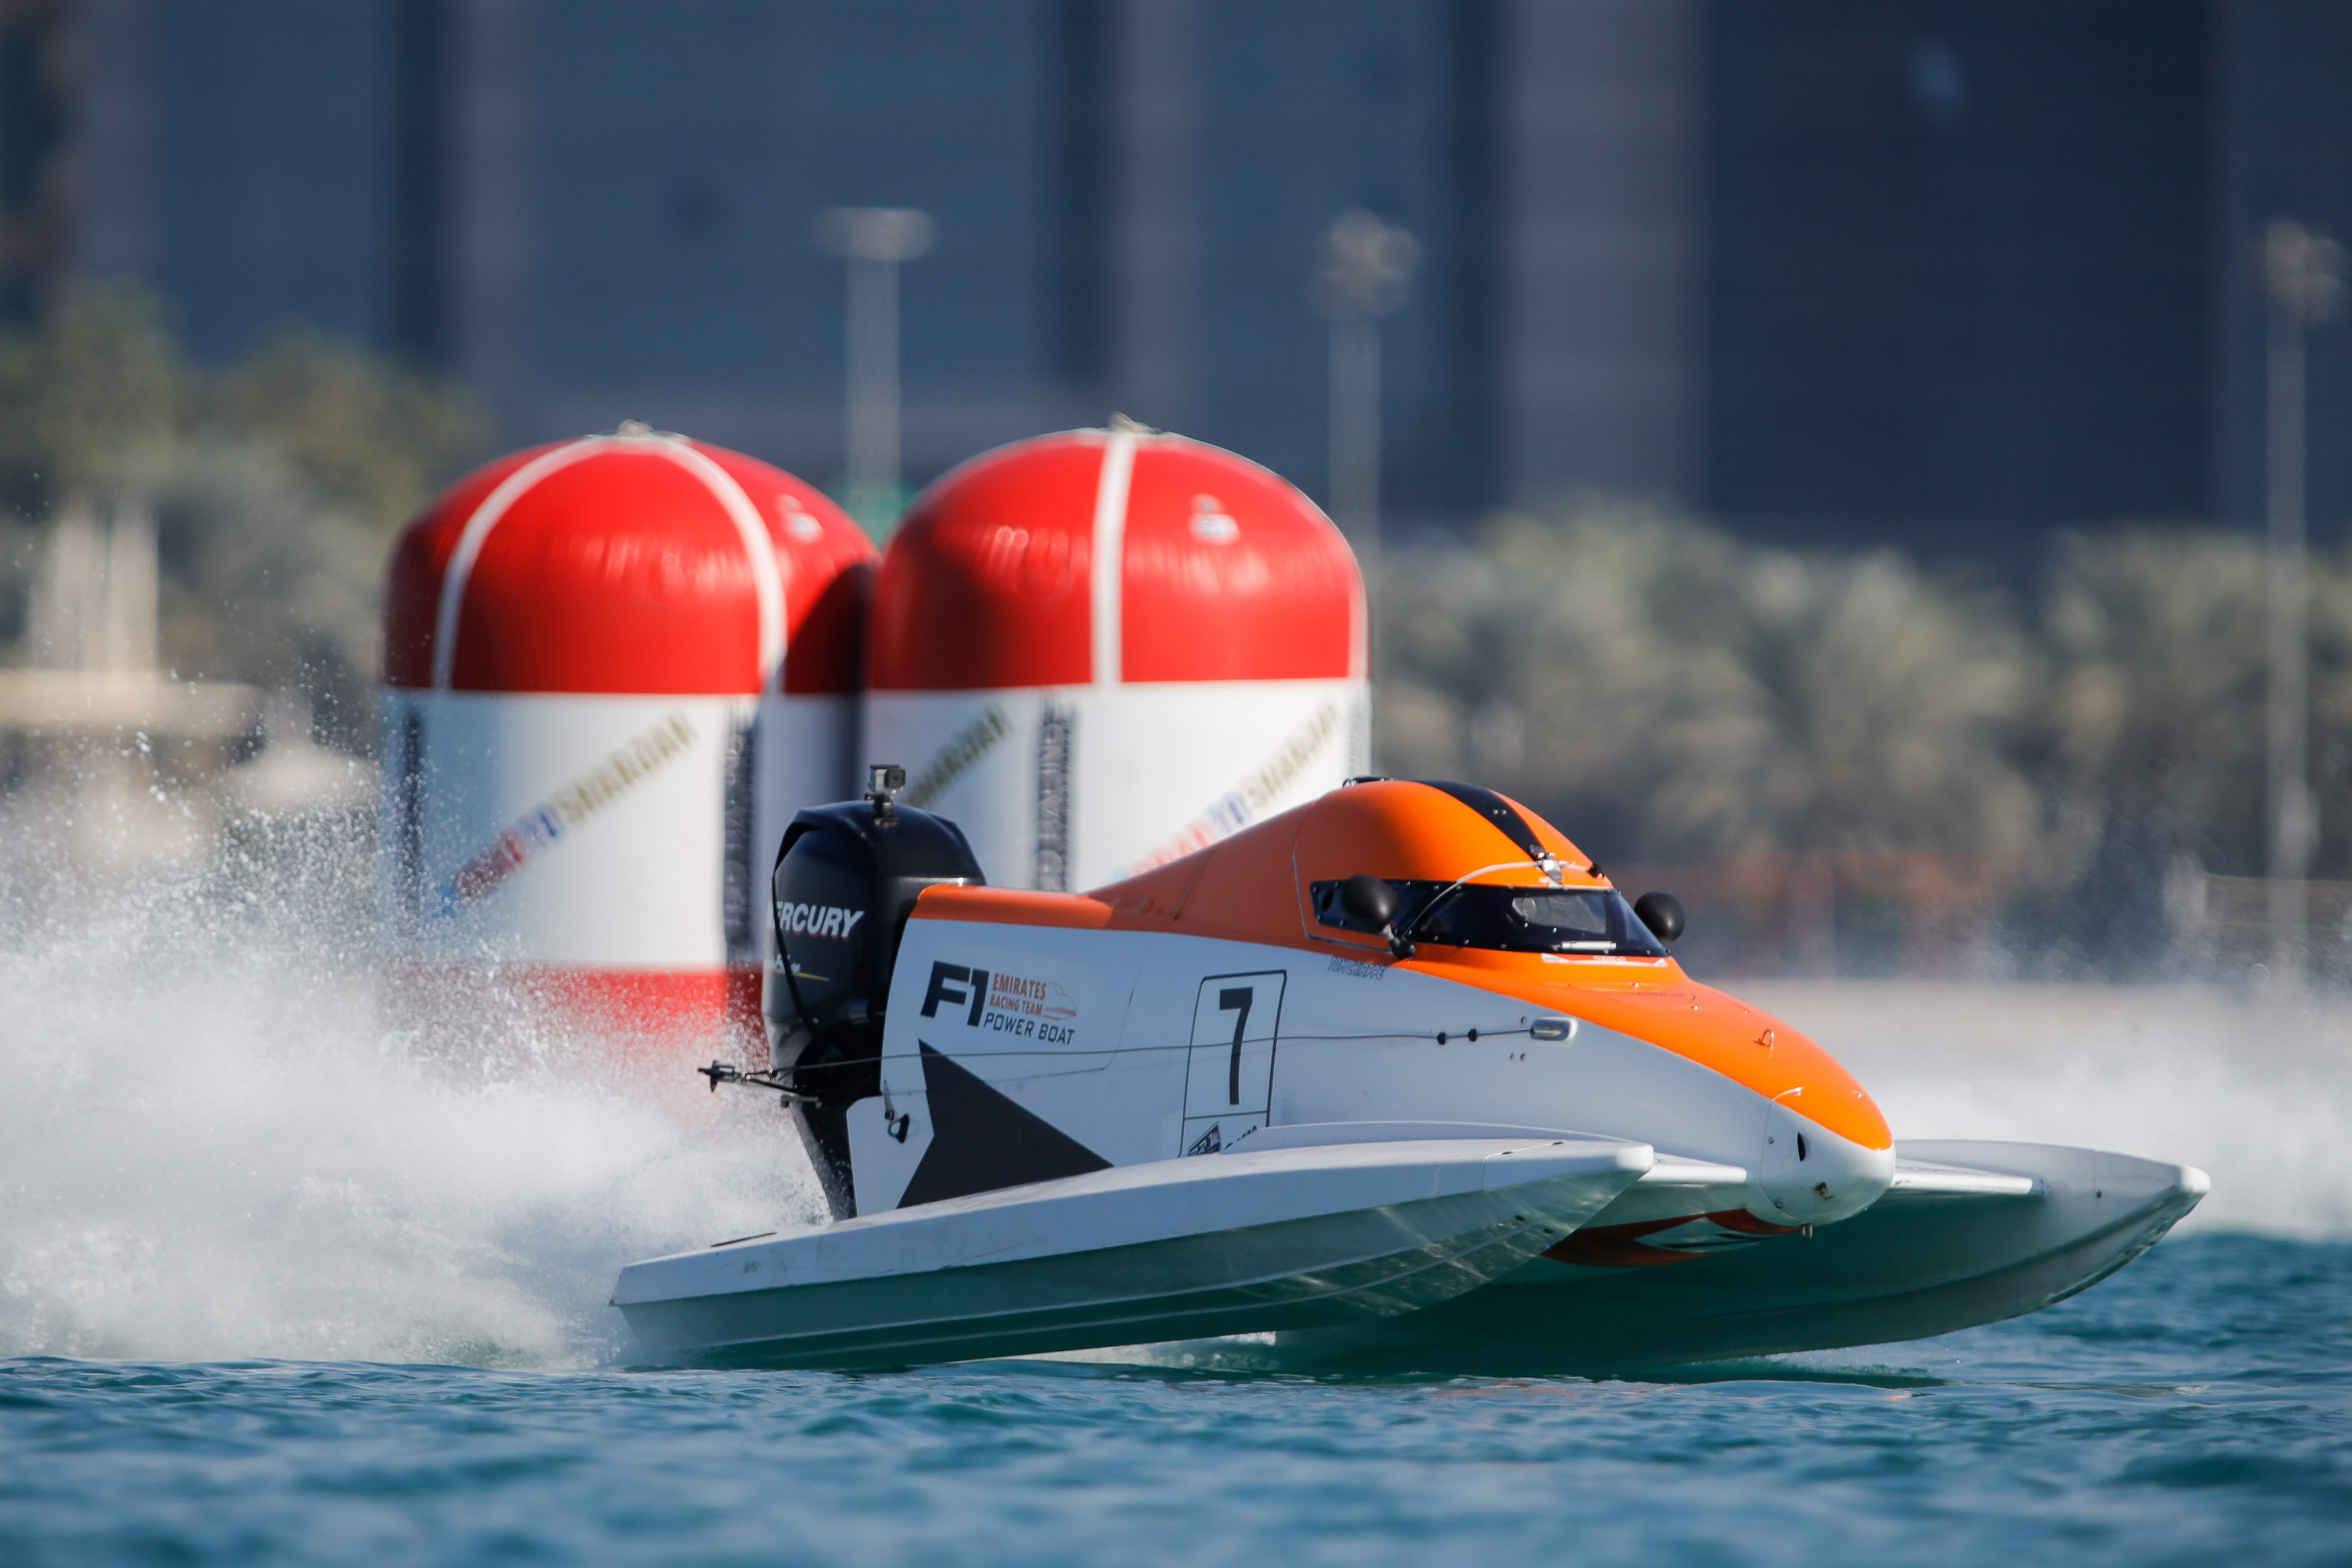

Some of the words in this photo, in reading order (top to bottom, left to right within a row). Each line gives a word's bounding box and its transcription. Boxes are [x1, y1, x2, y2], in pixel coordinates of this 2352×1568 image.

[920, 960, 990, 1027] F1
[993, 973, 1047, 1001] EMIRATES
[990, 994, 1020, 1012] RACING
[1021, 1000, 1043, 1017] TEAM
[984, 1012, 1035, 1037] POWER
[1038, 1022, 1076, 1045] BOAT
[1219, 986, 1253, 1105] 7
